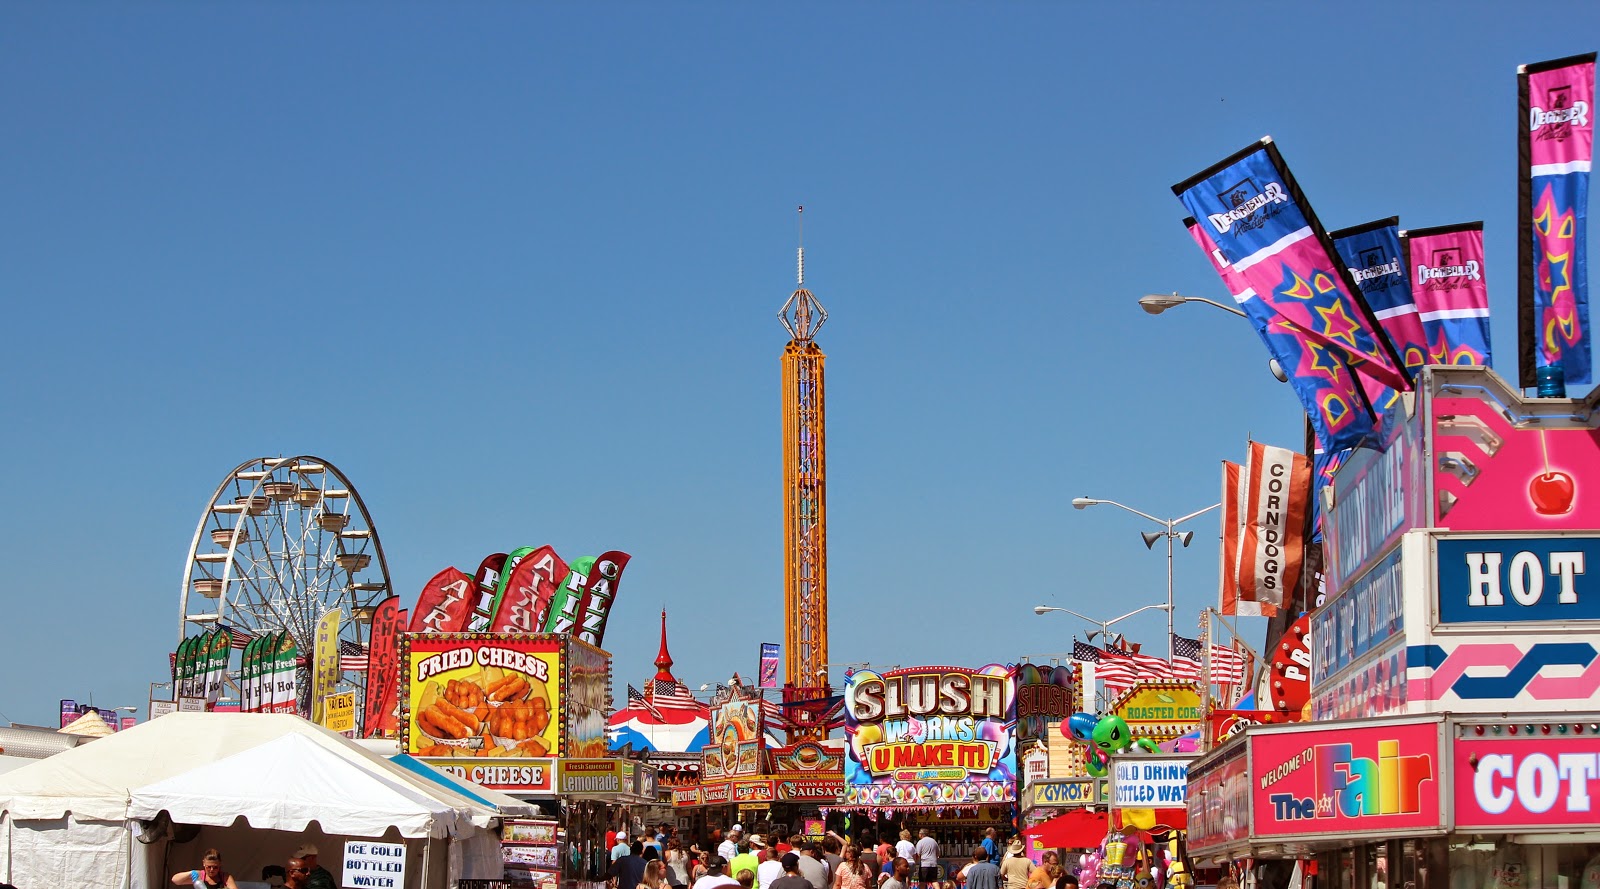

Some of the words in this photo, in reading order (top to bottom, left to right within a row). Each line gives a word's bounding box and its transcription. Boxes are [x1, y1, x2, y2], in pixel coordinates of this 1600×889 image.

[1465, 551, 1585, 607] HOT
[275, 657, 297, 669] Fresh
[317, 621, 328, 703] CHICKEN
[373, 606, 396, 715] CHICKEN
[418, 648, 474, 682] FRIED
[477, 647, 549, 682] CHEESE
[277, 681, 294, 692] Hot
[854, 673, 1006, 720] SLUSH
[1018, 684, 1073, 717] SLUSH
[1128, 707, 1174, 719] ROASTED
[885, 716, 975, 744] WORKS
[875, 748, 891, 770] U
[893, 744, 955, 769] MAKE
[958, 744, 984, 768] IT!
[472, 766, 544, 785] CHEESE
[569, 763, 584, 771] Fresh
[1117, 761, 1138, 781] COLD
[1261, 759, 1302, 789] WELCOME
[1302, 747, 1314, 765] TO
[562, 773, 619, 792] Lemonade
[1314, 739, 1433, 819] Fair
[705, 791, 728, 801] SAUSAGE
[736, 788, 755, 798] ICED
[756, 787, 772, 797] TEA
[1045, 783, 1083, 801] GYROS
[1115, 785, 1154, 802] BOTTLED
[1270, 793, 1315, 820] The
[348, 843, 367, 855] ICE
[371, 845, 403, 857] COLD
[346, 859, 402, 872] BOTTLED
[353, 875, 394, 887] WATER
